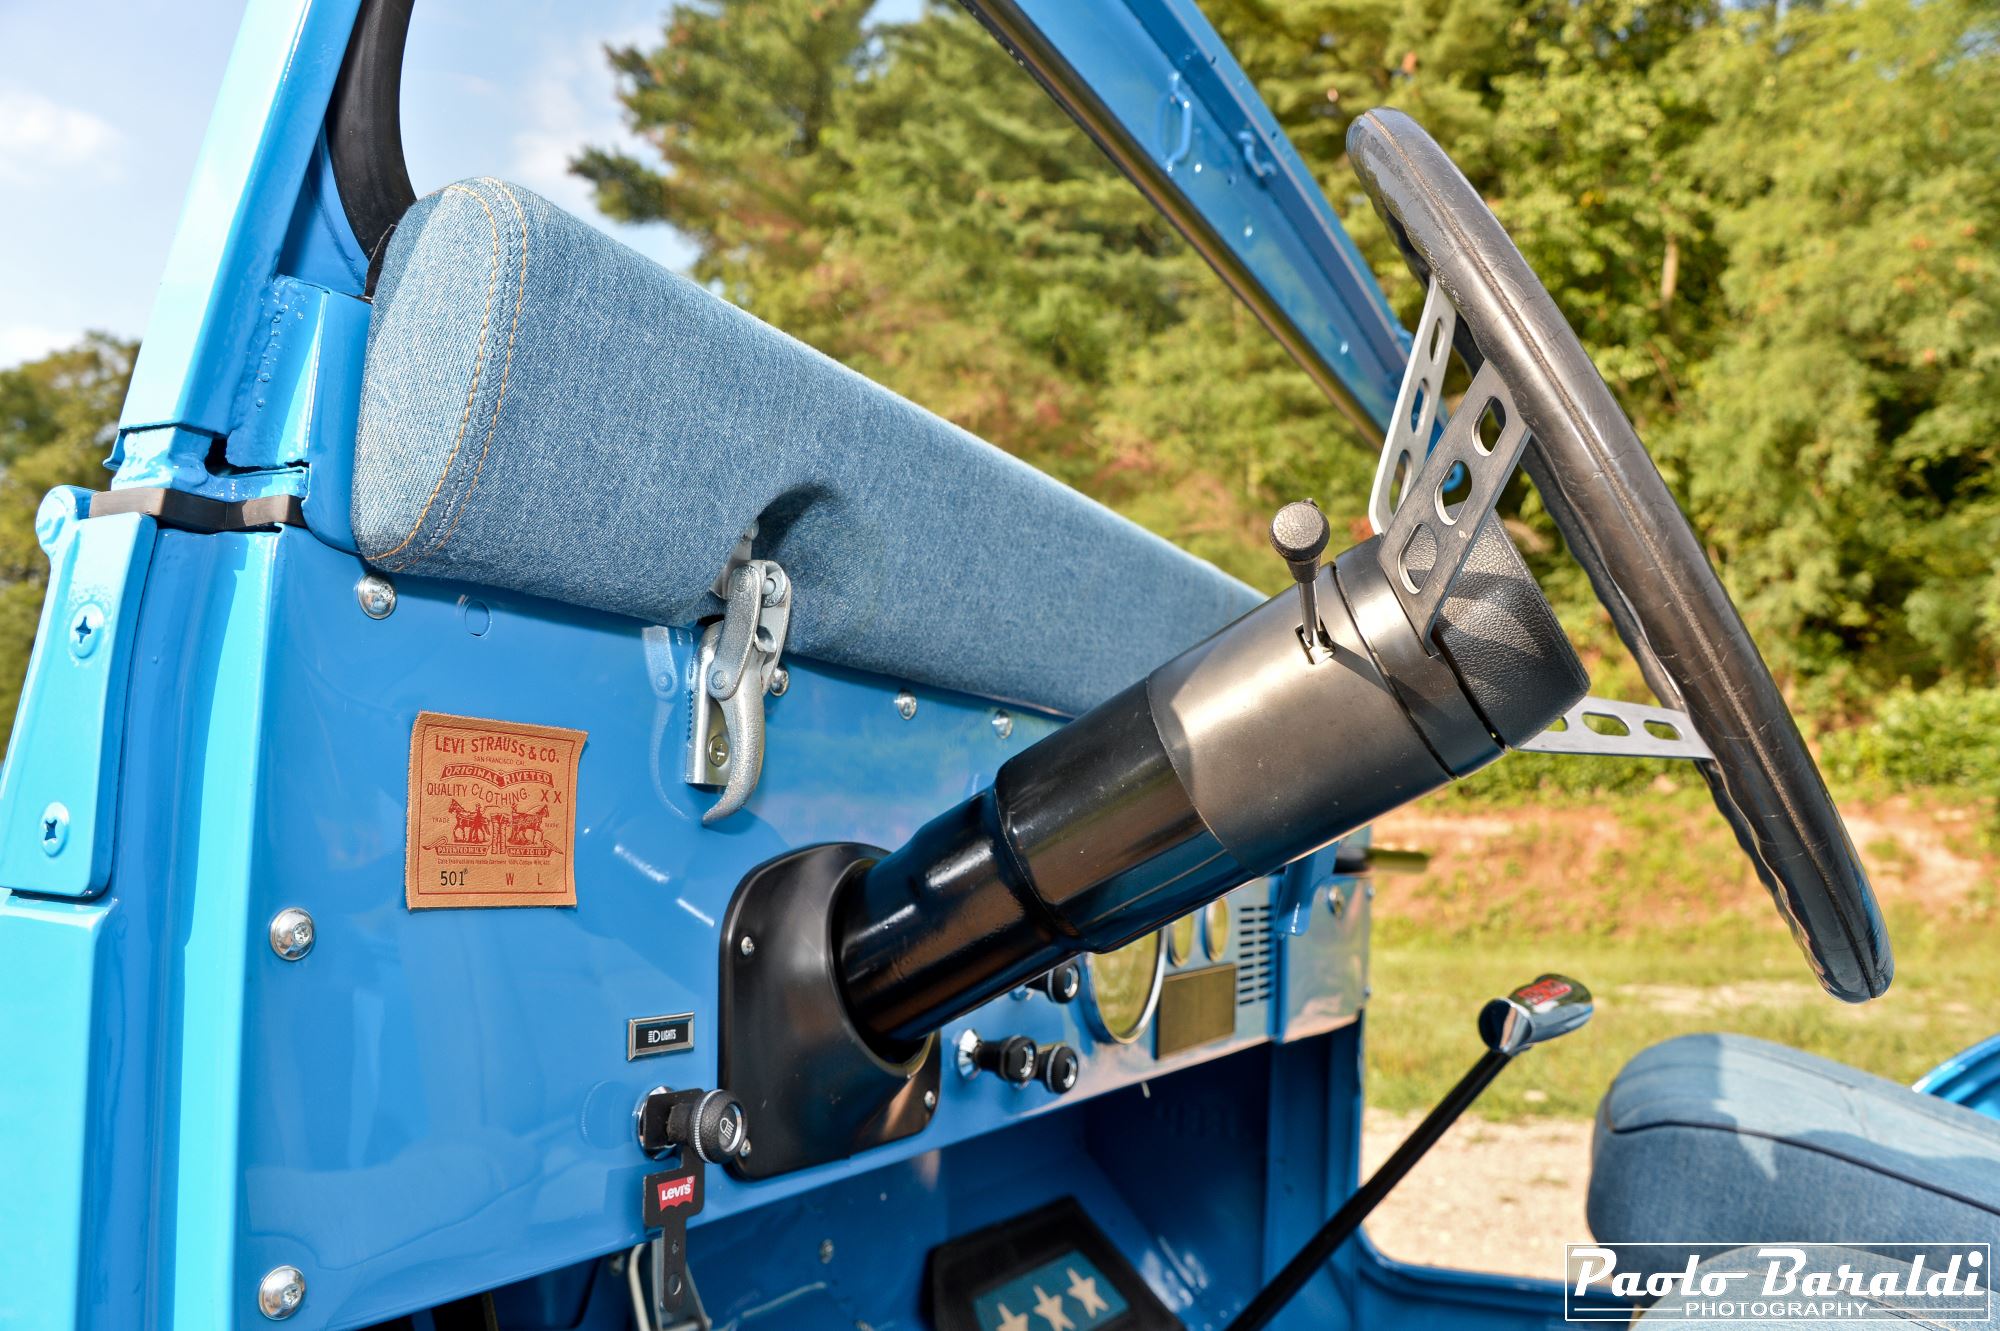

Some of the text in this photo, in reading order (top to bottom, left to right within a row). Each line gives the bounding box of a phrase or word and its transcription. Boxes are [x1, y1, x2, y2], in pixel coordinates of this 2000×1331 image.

[435, 735, 465, 754] LEVI
[471, 736, 526, 758] STRAUSS
[539, 747, 560, 763] CO.
[445, 765, 550, 785] ORIGINAL RIVETED
[427, 782, 468, 797] QUALITY
[505, 872, 515, 886] W
[537, 872, 543, 886] L
[660, 1028, 677, 1041] LIGHTS
